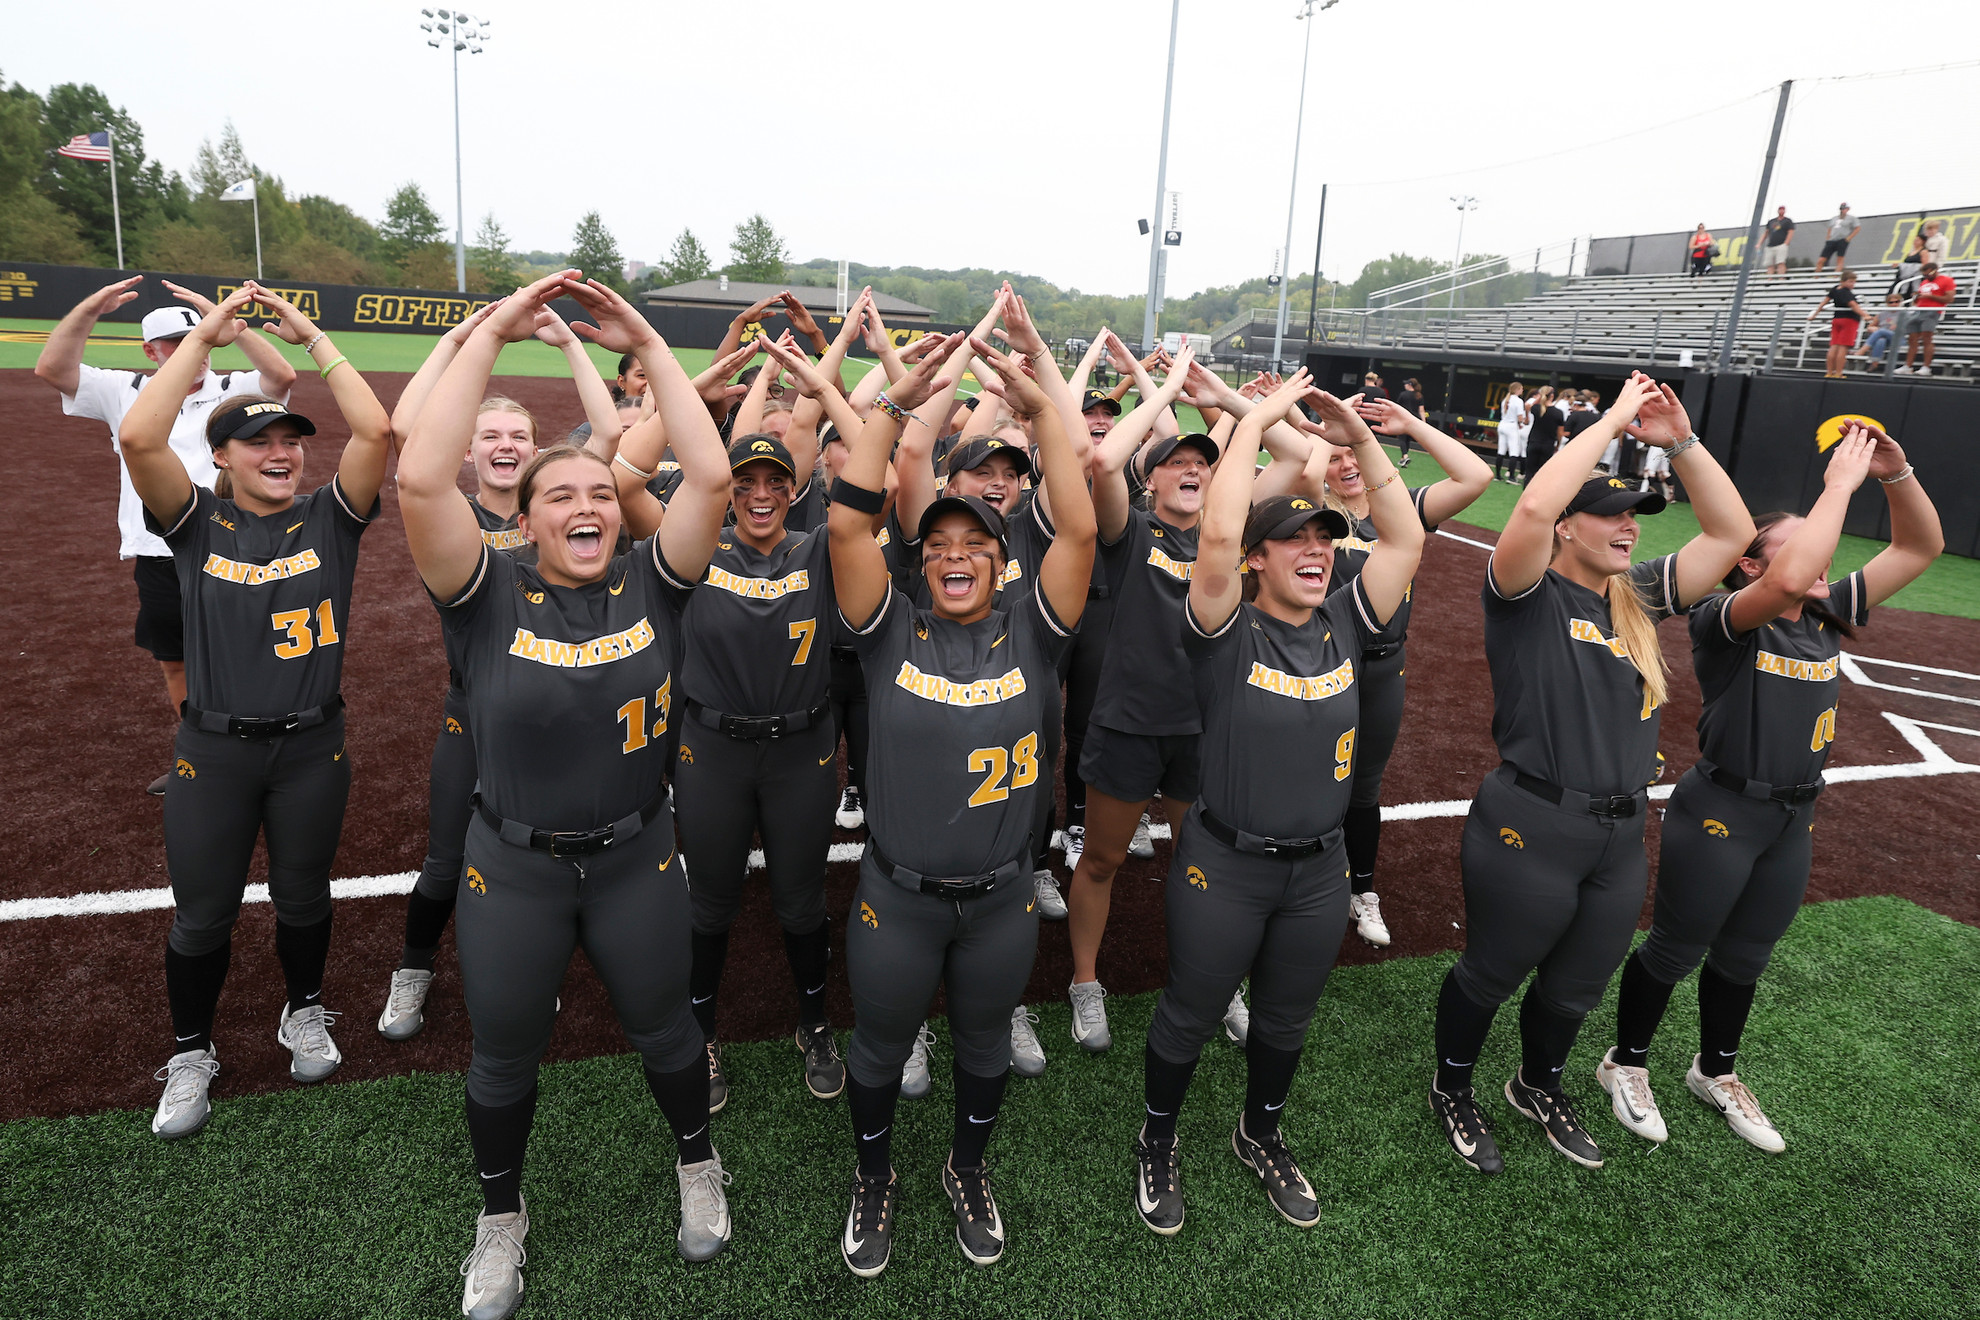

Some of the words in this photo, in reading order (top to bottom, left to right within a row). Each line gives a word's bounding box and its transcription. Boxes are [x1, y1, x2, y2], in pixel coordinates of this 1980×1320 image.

[181, 311, 196, 327] I
[243, 403, 289, 417] IOWA
[271, 598, 340, 660] 31
[788, 617, 817, 666] 7
[895, 659, 1027, 707] HAWKEYES
[1246, 657, 1355, 700] HAWKEYES
[617, 671, 671, 755] 13
[967, 731, 1039, 808] 28
[1333, 726, 1356, 782] 9
